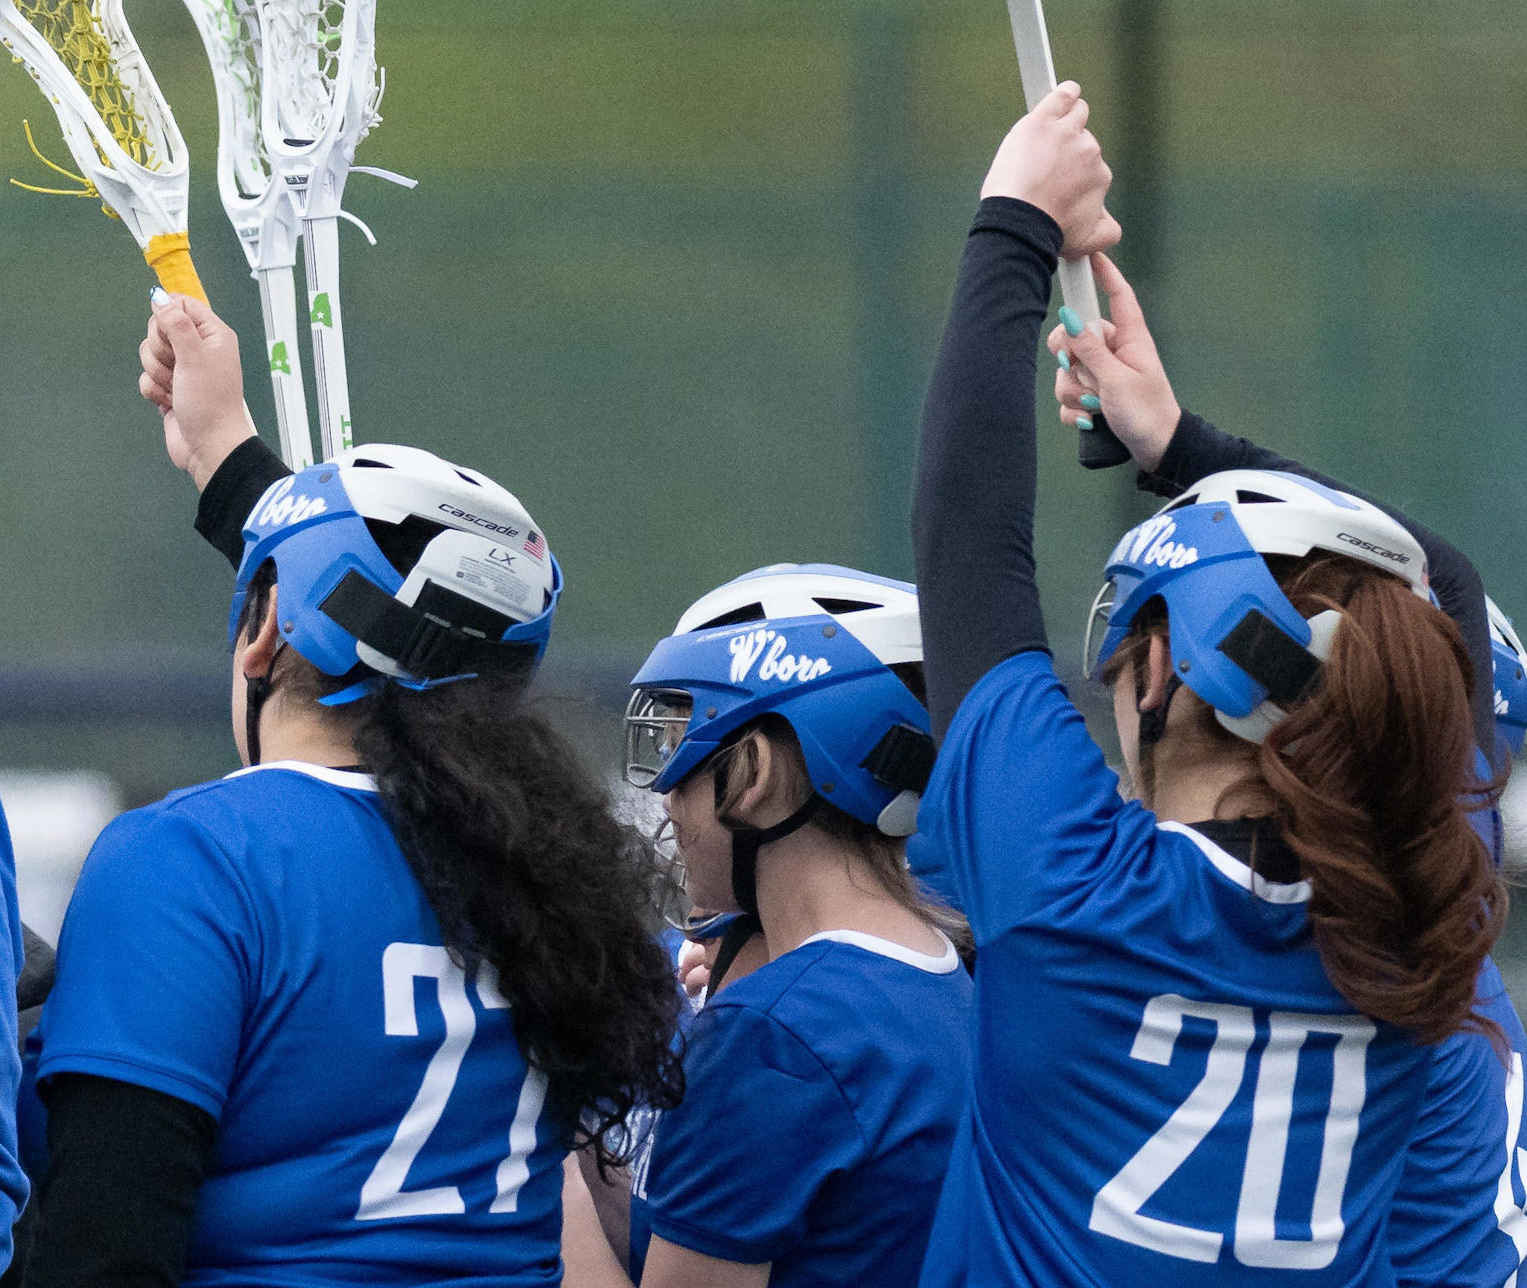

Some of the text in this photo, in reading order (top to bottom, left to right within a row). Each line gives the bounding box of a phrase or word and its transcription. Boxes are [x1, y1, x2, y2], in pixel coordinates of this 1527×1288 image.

[438, 503, 519, 539] cascade
[487, 548, 517, 566] LX
[1336, 532, 1411, 565] cascade
[1089, 993, 1378, 1270] 20
